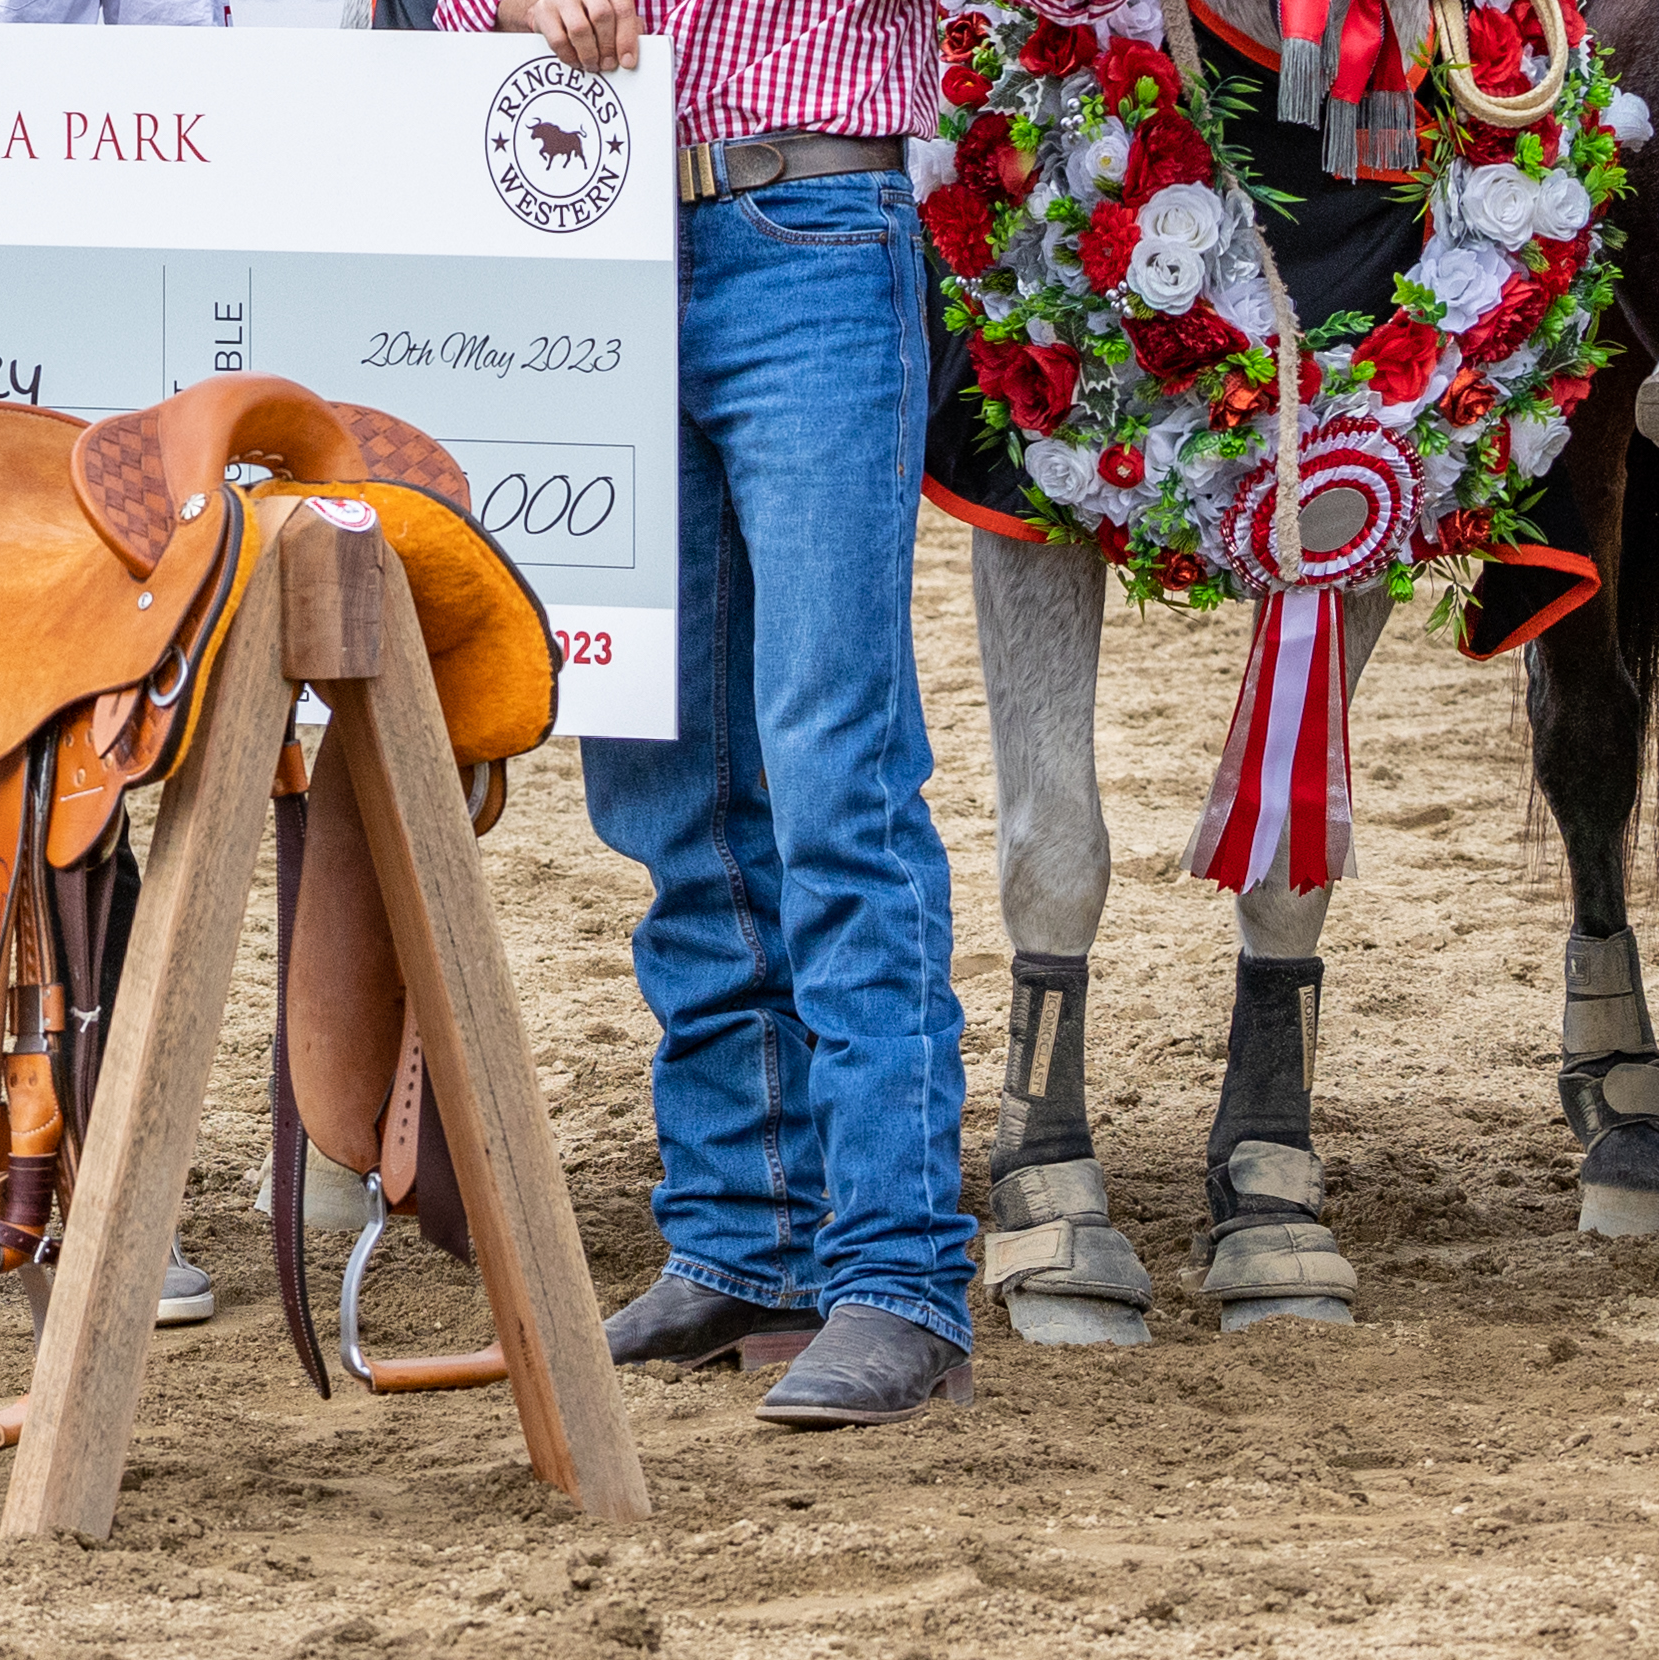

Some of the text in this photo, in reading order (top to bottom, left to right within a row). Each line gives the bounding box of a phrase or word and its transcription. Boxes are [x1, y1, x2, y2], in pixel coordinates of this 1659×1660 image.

[497, 61, 619, 125] RINGERS
[62, 110, 211, 163] PARK
[499, 162, 620, 228] WESTERN
[361, 330, 621, 379] 20th May 2023
[464, 471, 615, 536] 000
[554, 629, 612, 666] 023
